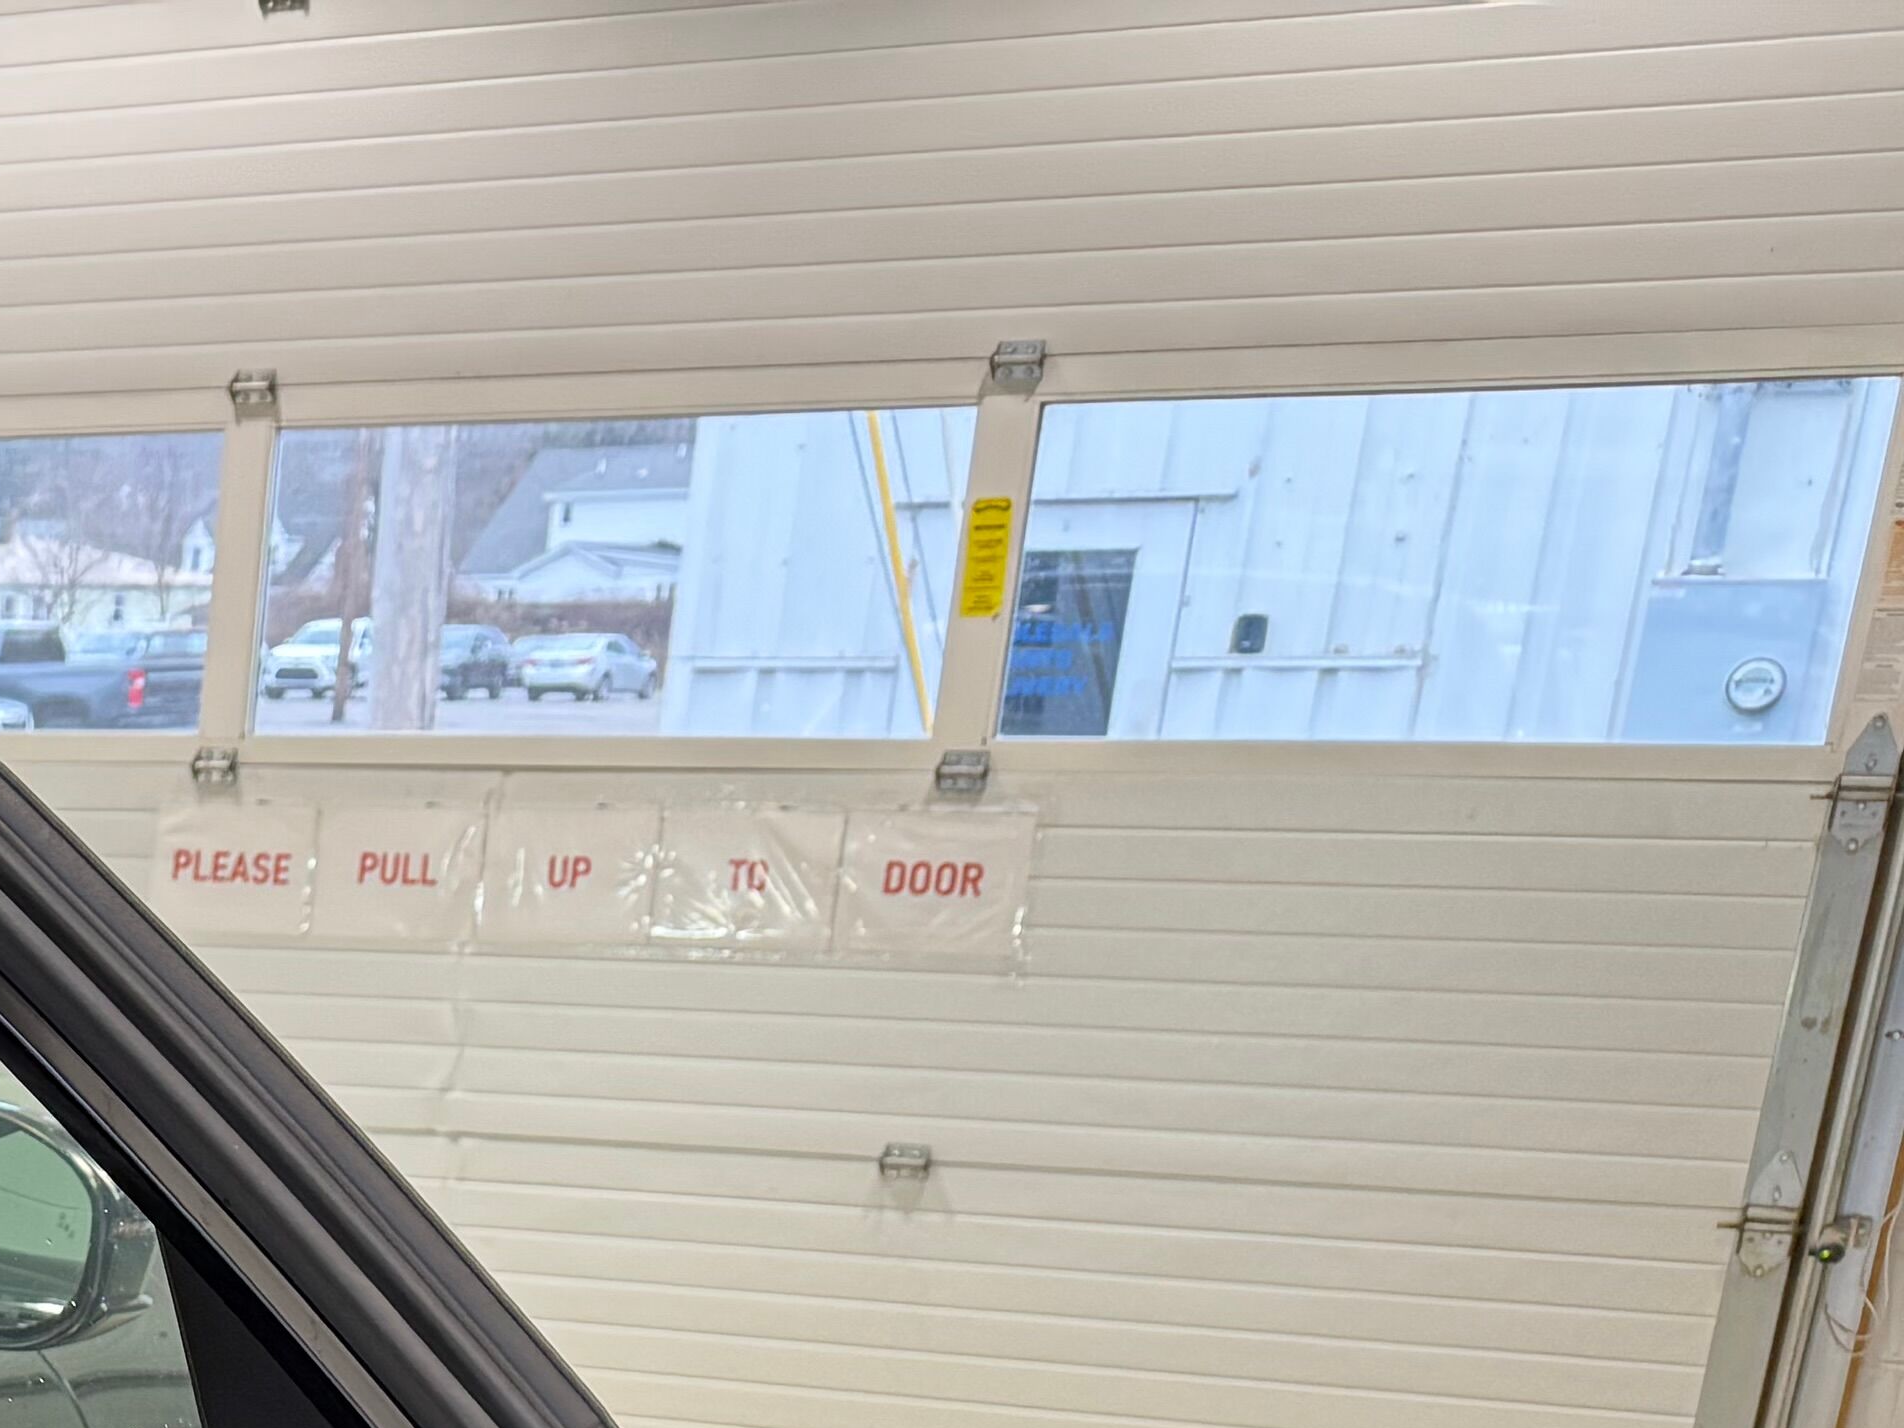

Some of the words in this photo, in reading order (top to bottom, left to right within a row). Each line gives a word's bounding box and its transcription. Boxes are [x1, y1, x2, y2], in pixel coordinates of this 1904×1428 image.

[172, 849, 292, 886] PLEASE
[358, 851, 437, 887] PULL
[547, 854, 592, 890] UP
[882, 860, 984, 897] DOOR
